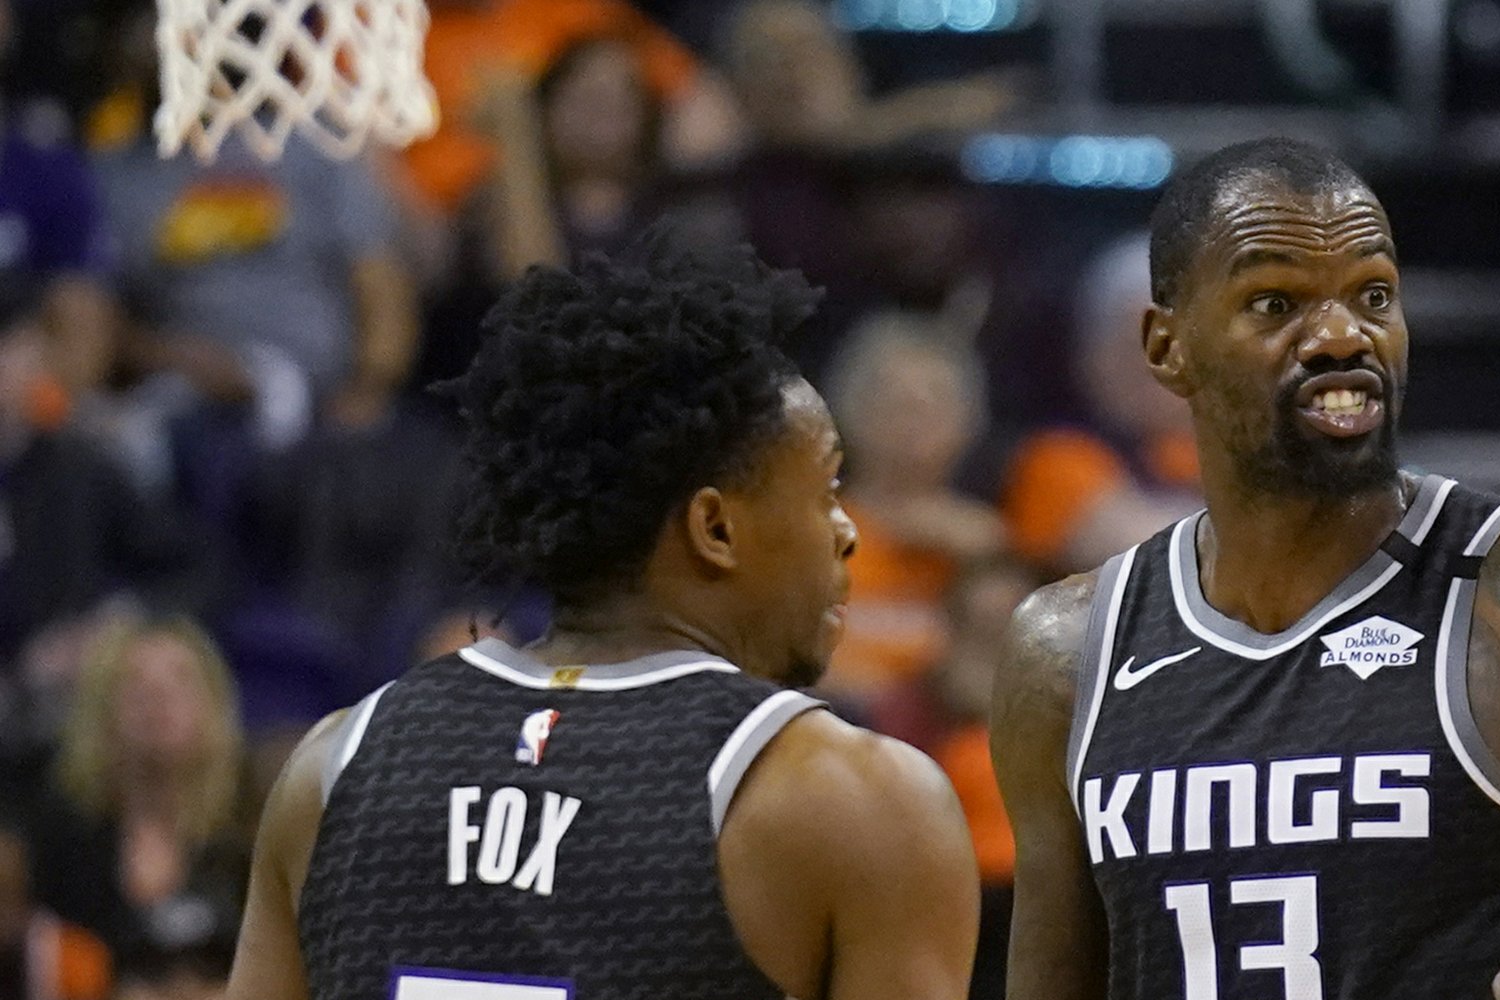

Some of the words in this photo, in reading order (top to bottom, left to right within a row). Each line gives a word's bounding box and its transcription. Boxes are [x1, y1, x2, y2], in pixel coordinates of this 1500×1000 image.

[1361, 626, 1388, 638] BLUE
[1345, 633, 1401, 648] DIAMOND
[1324, 651, 1414, 664] ALMONDS
[1083, 753, 1431, 864] KINGS
[447, 785, 582, 896] FOX
